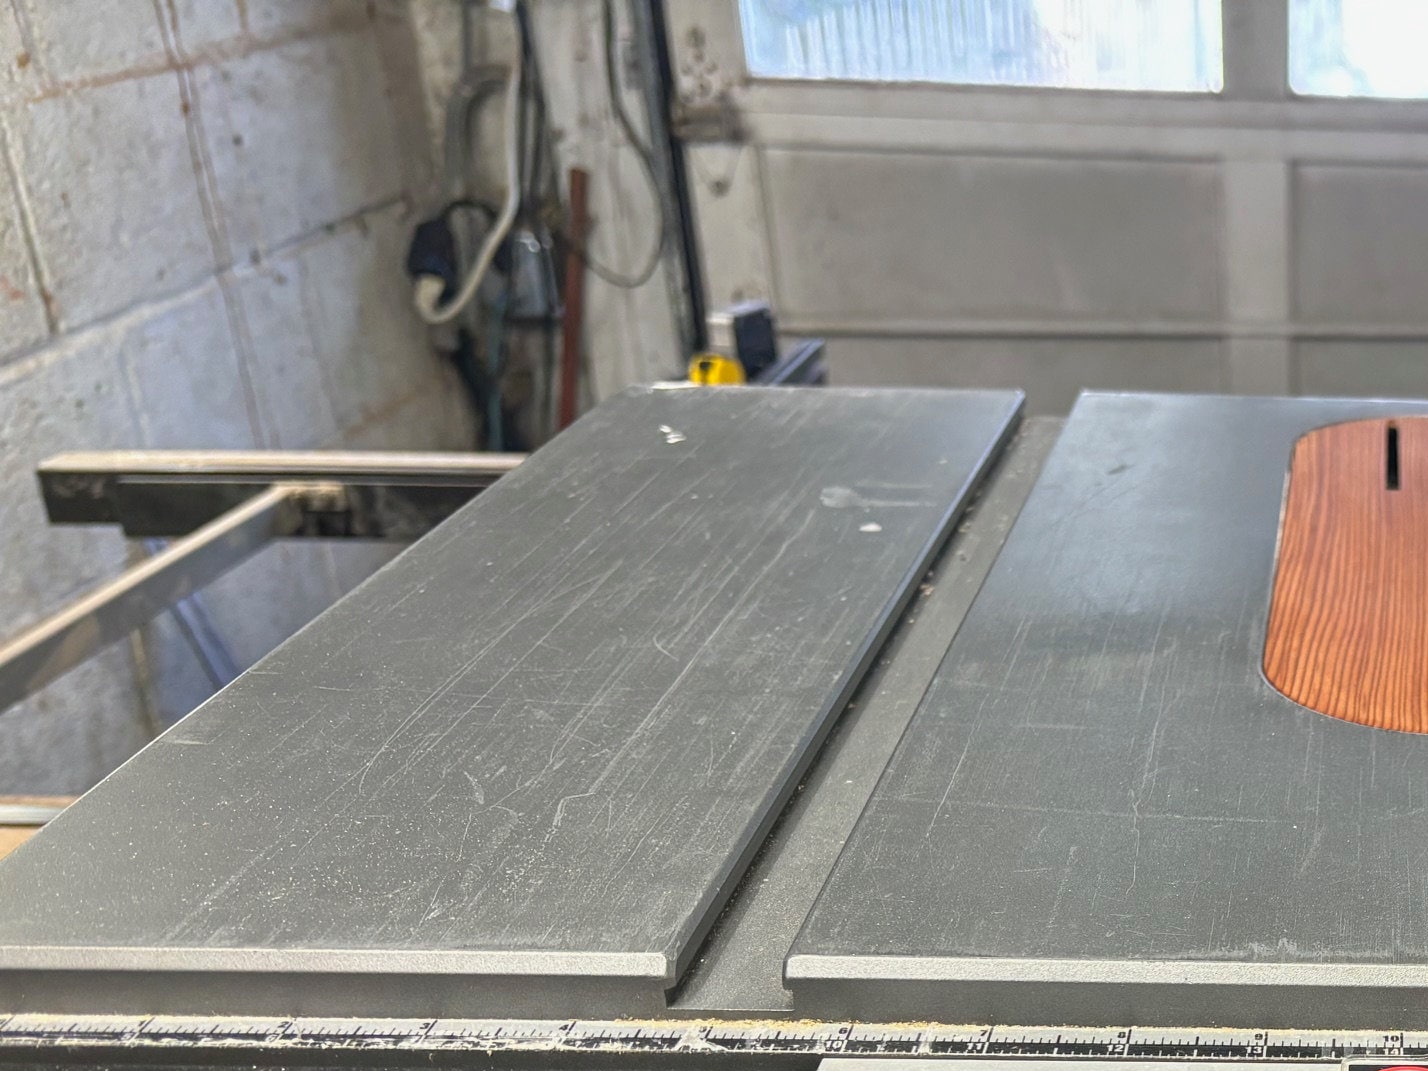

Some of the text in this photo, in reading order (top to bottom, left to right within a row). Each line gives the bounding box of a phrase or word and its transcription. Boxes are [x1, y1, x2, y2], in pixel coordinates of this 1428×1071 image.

[838, 1027, 848, 1035] 6
[1254, 1033, 1264, 1041] 9
[825, 1040, 841, 1049] 10
[1106, 1044, 1123, 1052] 12
[1245, 1046, 1262, 1054] 13
